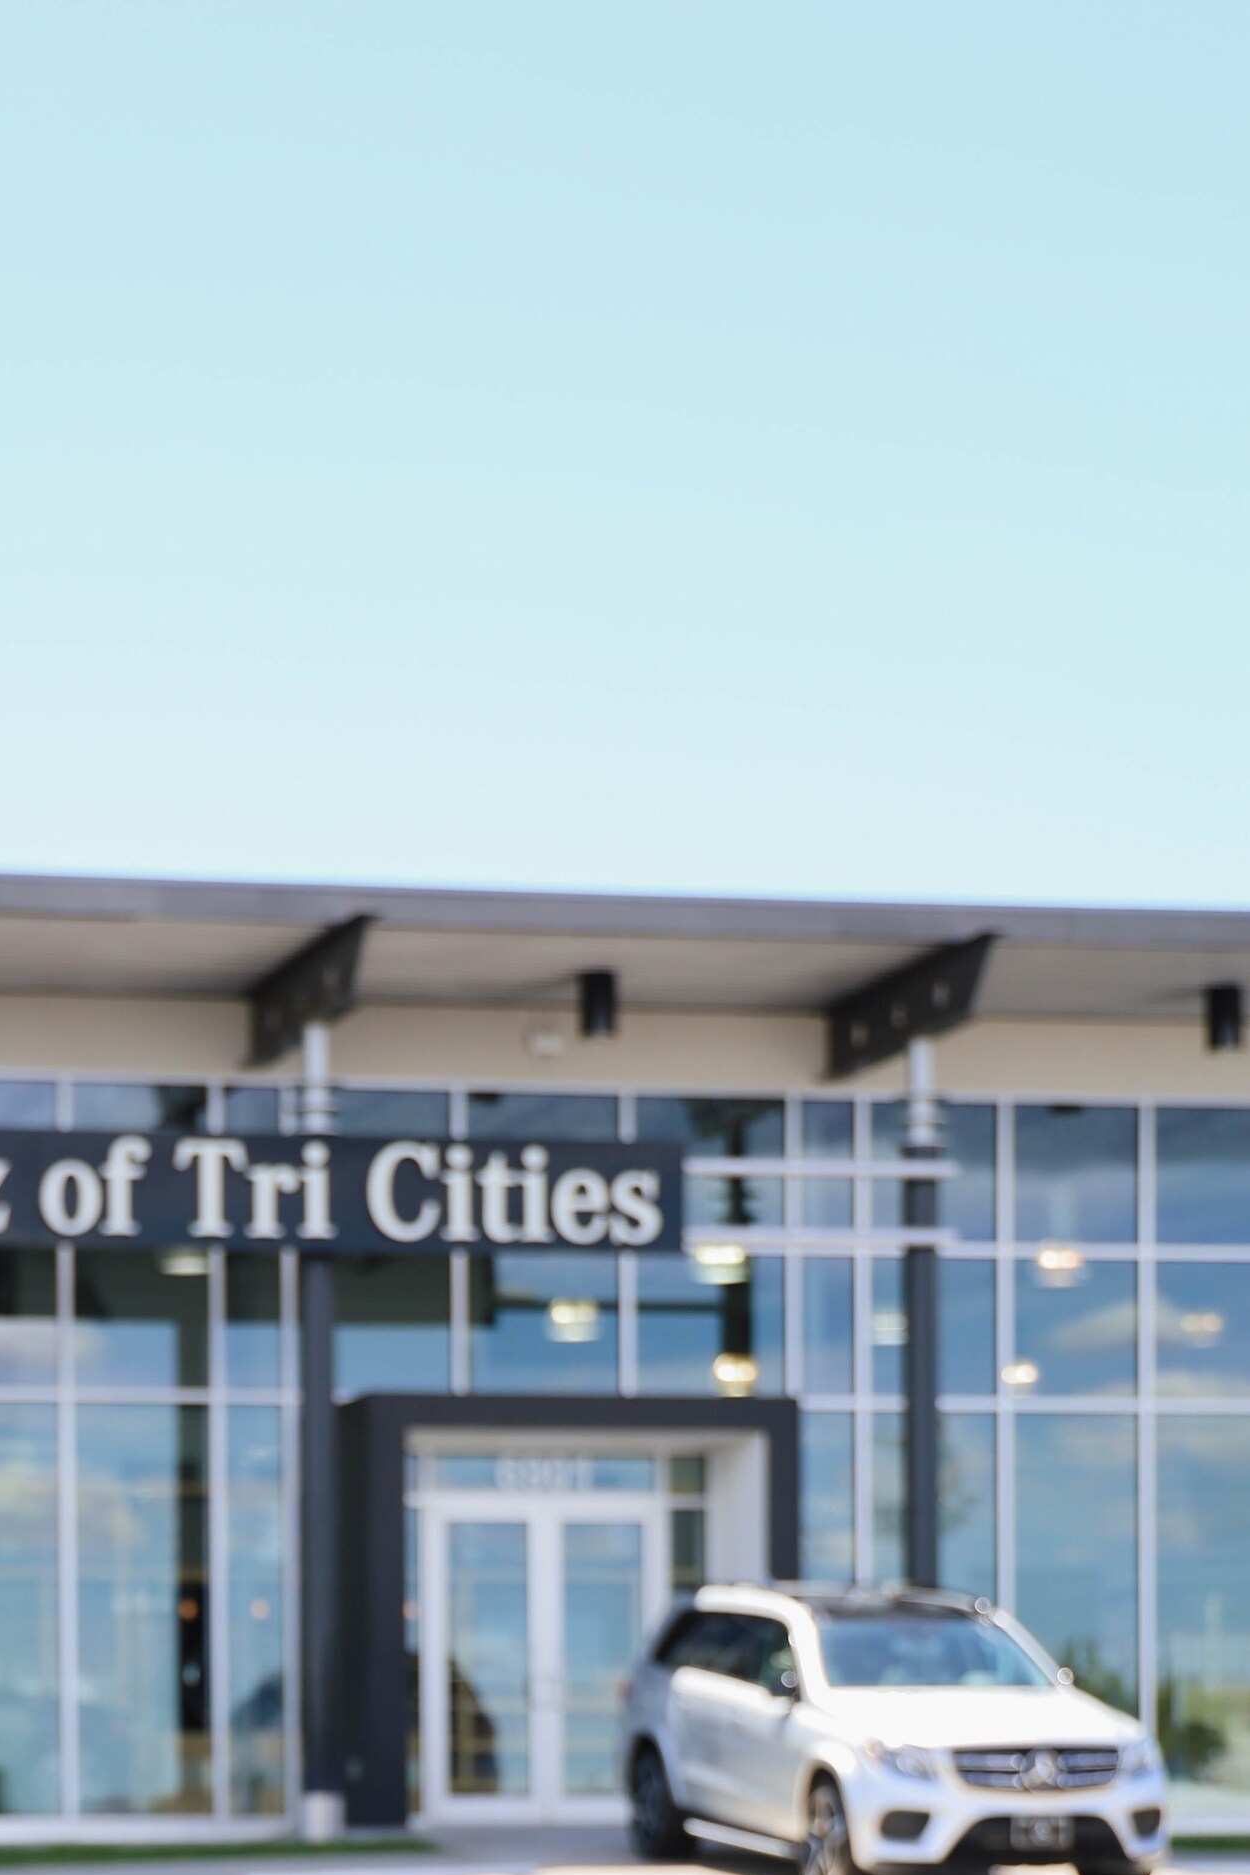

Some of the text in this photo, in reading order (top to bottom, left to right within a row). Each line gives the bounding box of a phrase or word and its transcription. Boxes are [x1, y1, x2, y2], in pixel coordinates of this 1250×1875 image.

[38, 1134, 151, 1237] of
[172, 1136, 337, 1240] Tri
[366, 1140, 665, 1246] Cities
